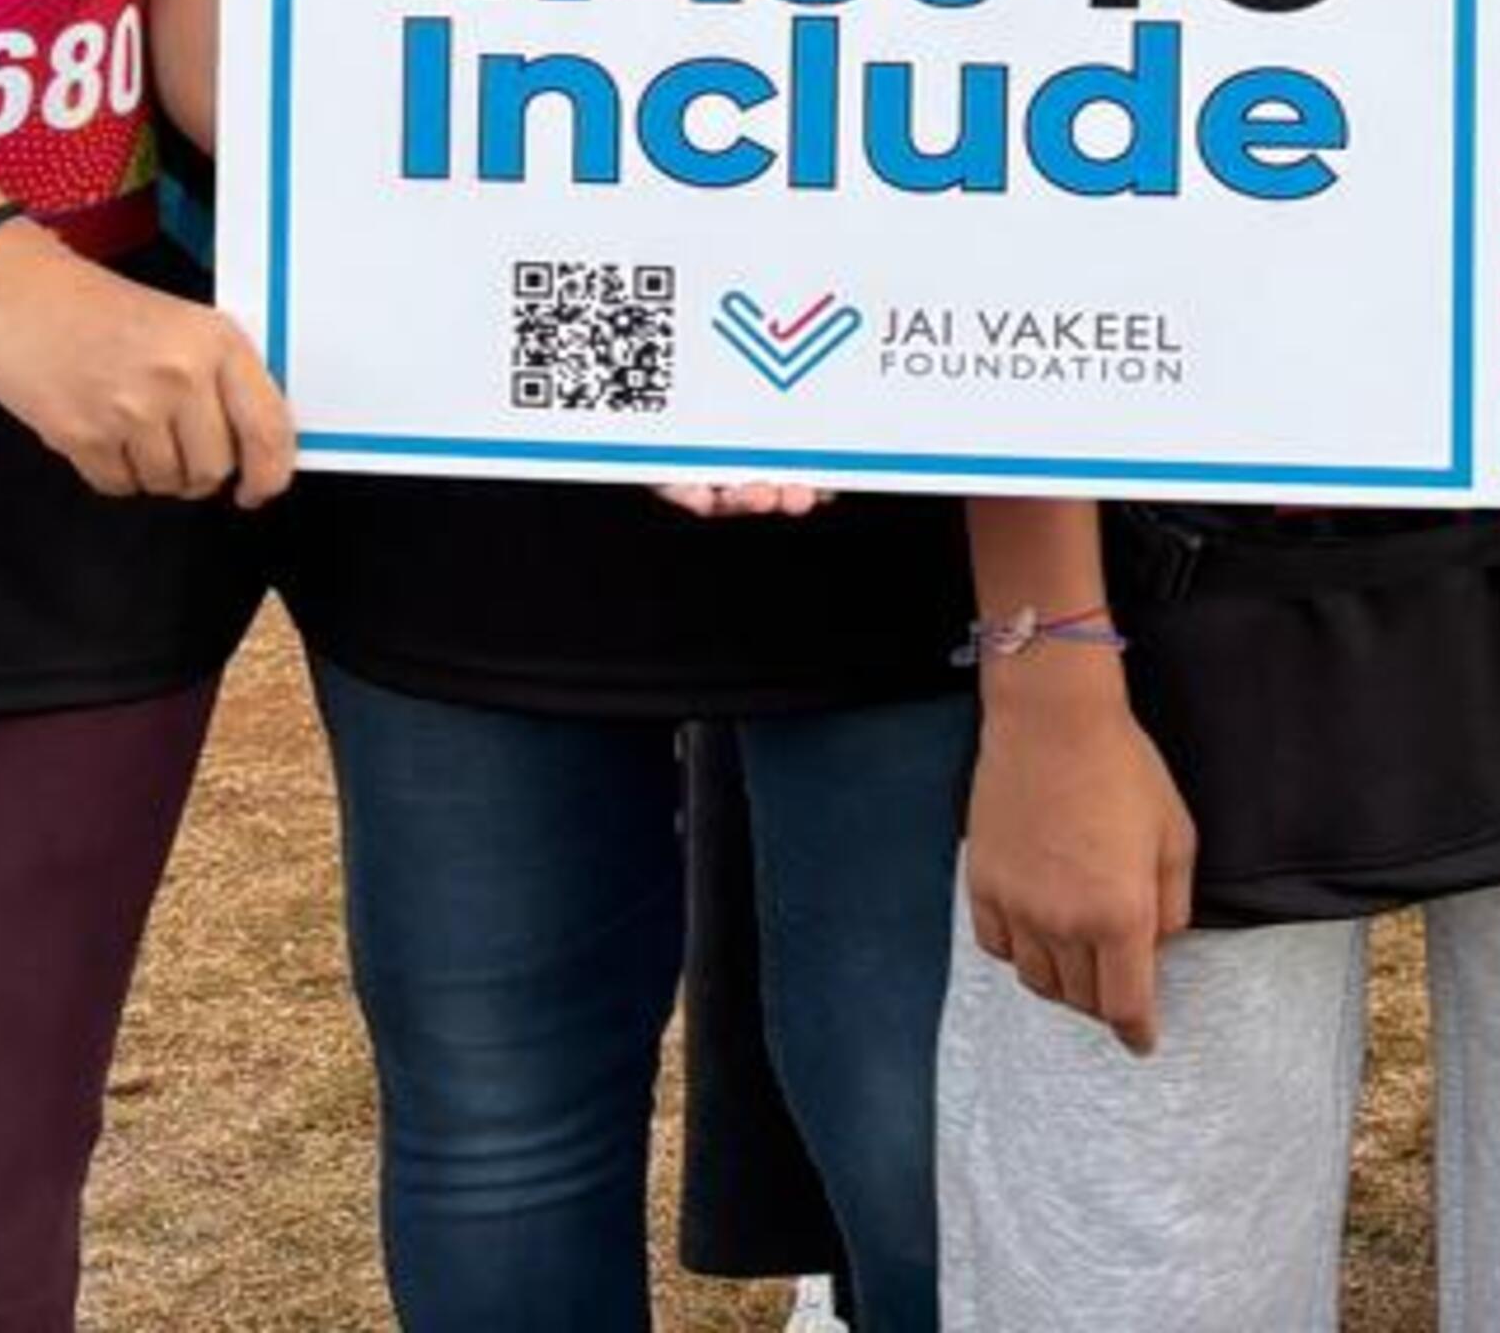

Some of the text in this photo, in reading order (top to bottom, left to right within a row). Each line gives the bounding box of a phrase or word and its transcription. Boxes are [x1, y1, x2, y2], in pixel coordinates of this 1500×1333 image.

[400, 15, 1350, 201] Include
[881, 308, 1182, 353] JAI VAKEEL
[880, 352, 1184, 385] FOUNDATION
